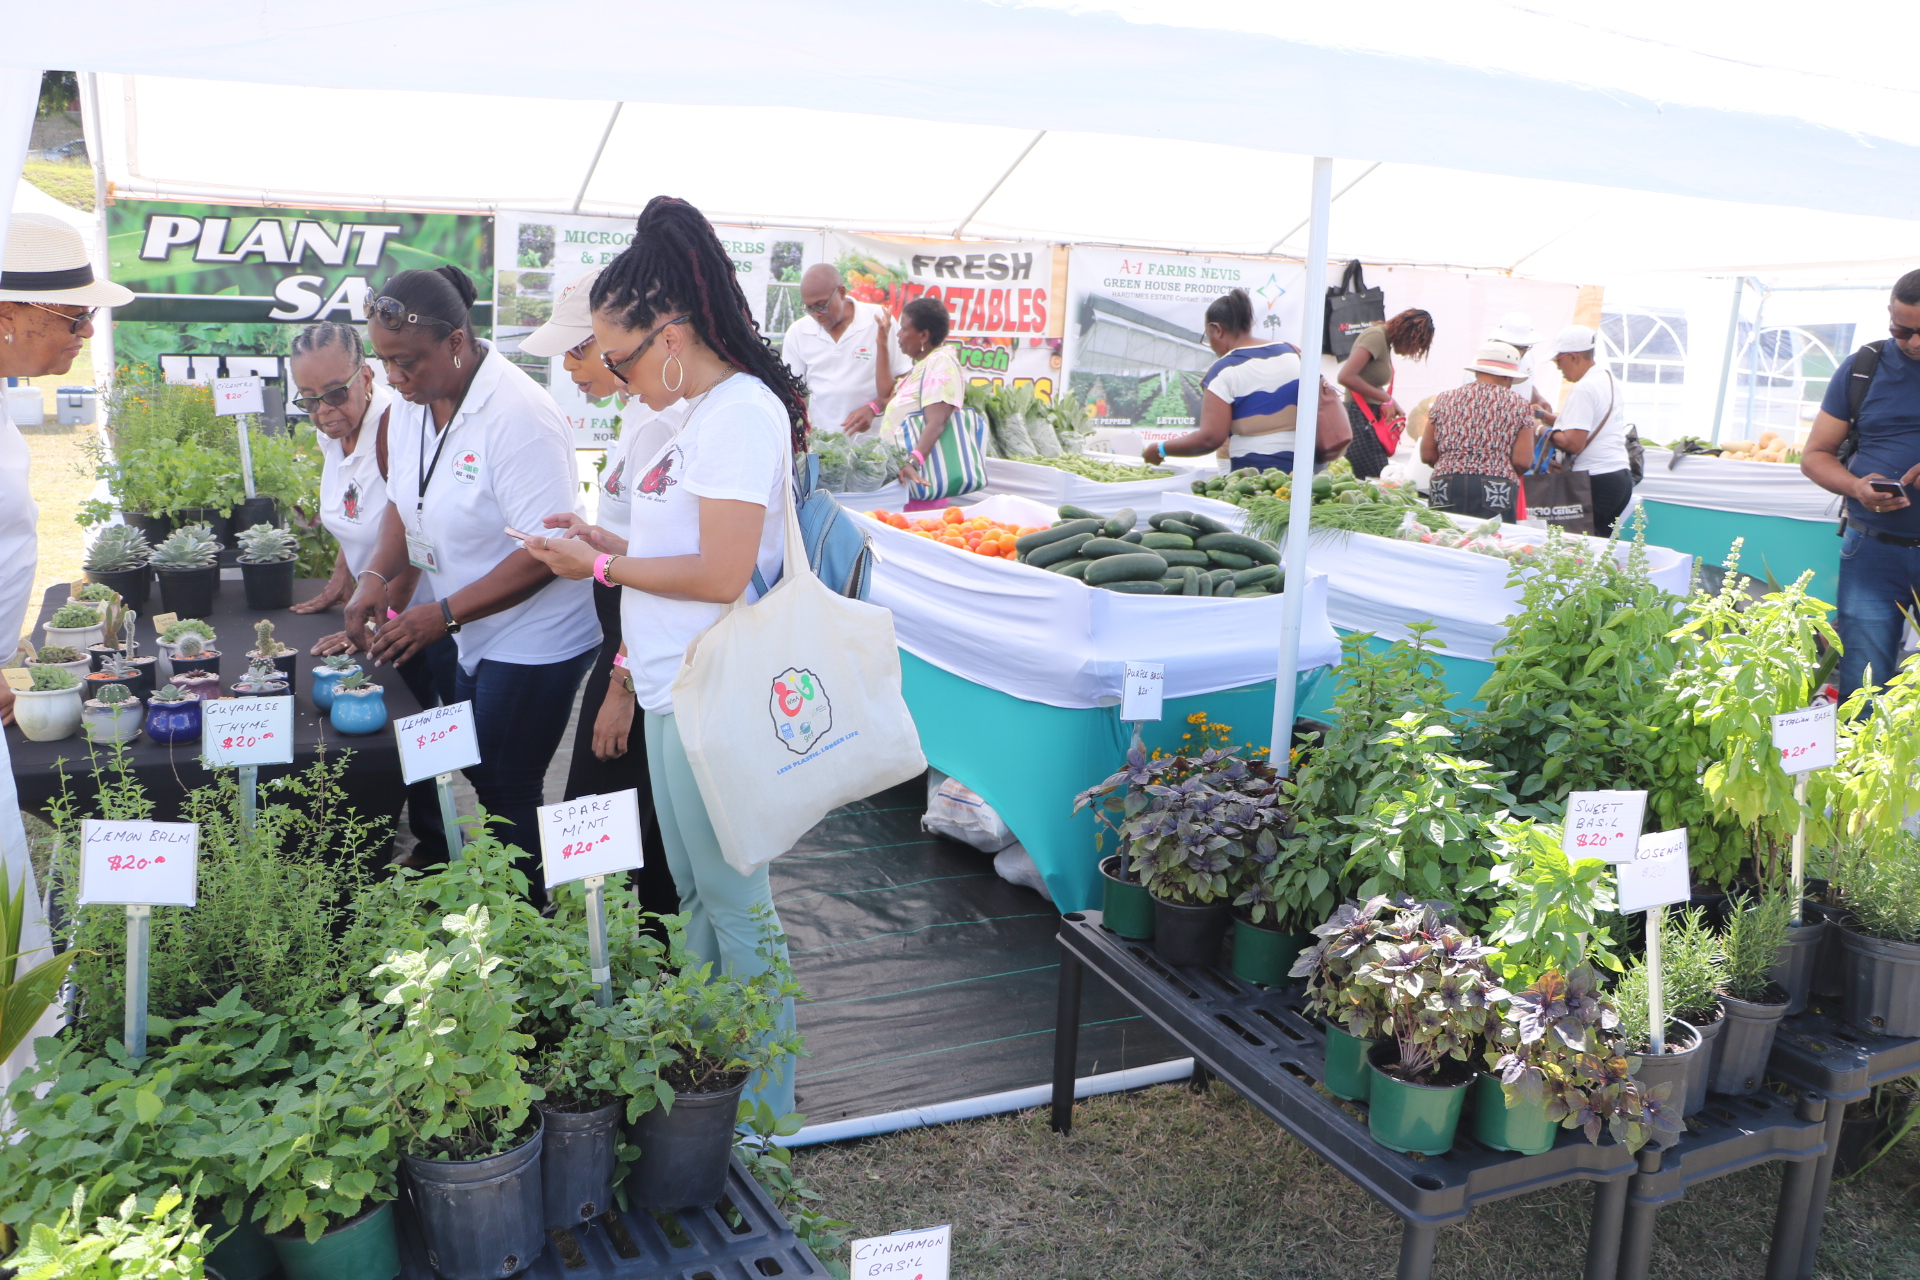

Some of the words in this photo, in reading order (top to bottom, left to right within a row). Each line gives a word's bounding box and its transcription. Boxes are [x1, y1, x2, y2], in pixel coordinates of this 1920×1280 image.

[140, 215, 401, 266] PLANT
[721, 240, 765, 254] ERBS
[580, 251, 594, 264] &
[911, 252, 1033, 281] FRESH
[1119, 259, 1142, 275] A-1
[1147, 263, 1197, 278] FARMS
[1200, 267, 1241, 281] NEVIS
[1103, 278, 1141, 289] GREEN
[1144, 280, 1181, 292] HOUSE
[1184, 283, 1251, 296] PRODUCTN
[268, 273, 373, 322] SA
[888, 281, 1047, 333] VETABLES
[1156, 416, 1196, 425] LETTUCE
[1552, 504, 1583, 515] CENTER
[215, 719, 269, 734] THYME
[402, 712, 433, 731] LEMON
[776, 764, 793, 775] LESS
[820, 737, 845, 753] LONGER
[845, 730, 859, 740] LIFE
[552, 800, 612, 823] SPARE
[1574, 799, 1624, 815] SWEET
[87, 826, 143, 843] LEMON
[149, 829, 191, 844] BALM
